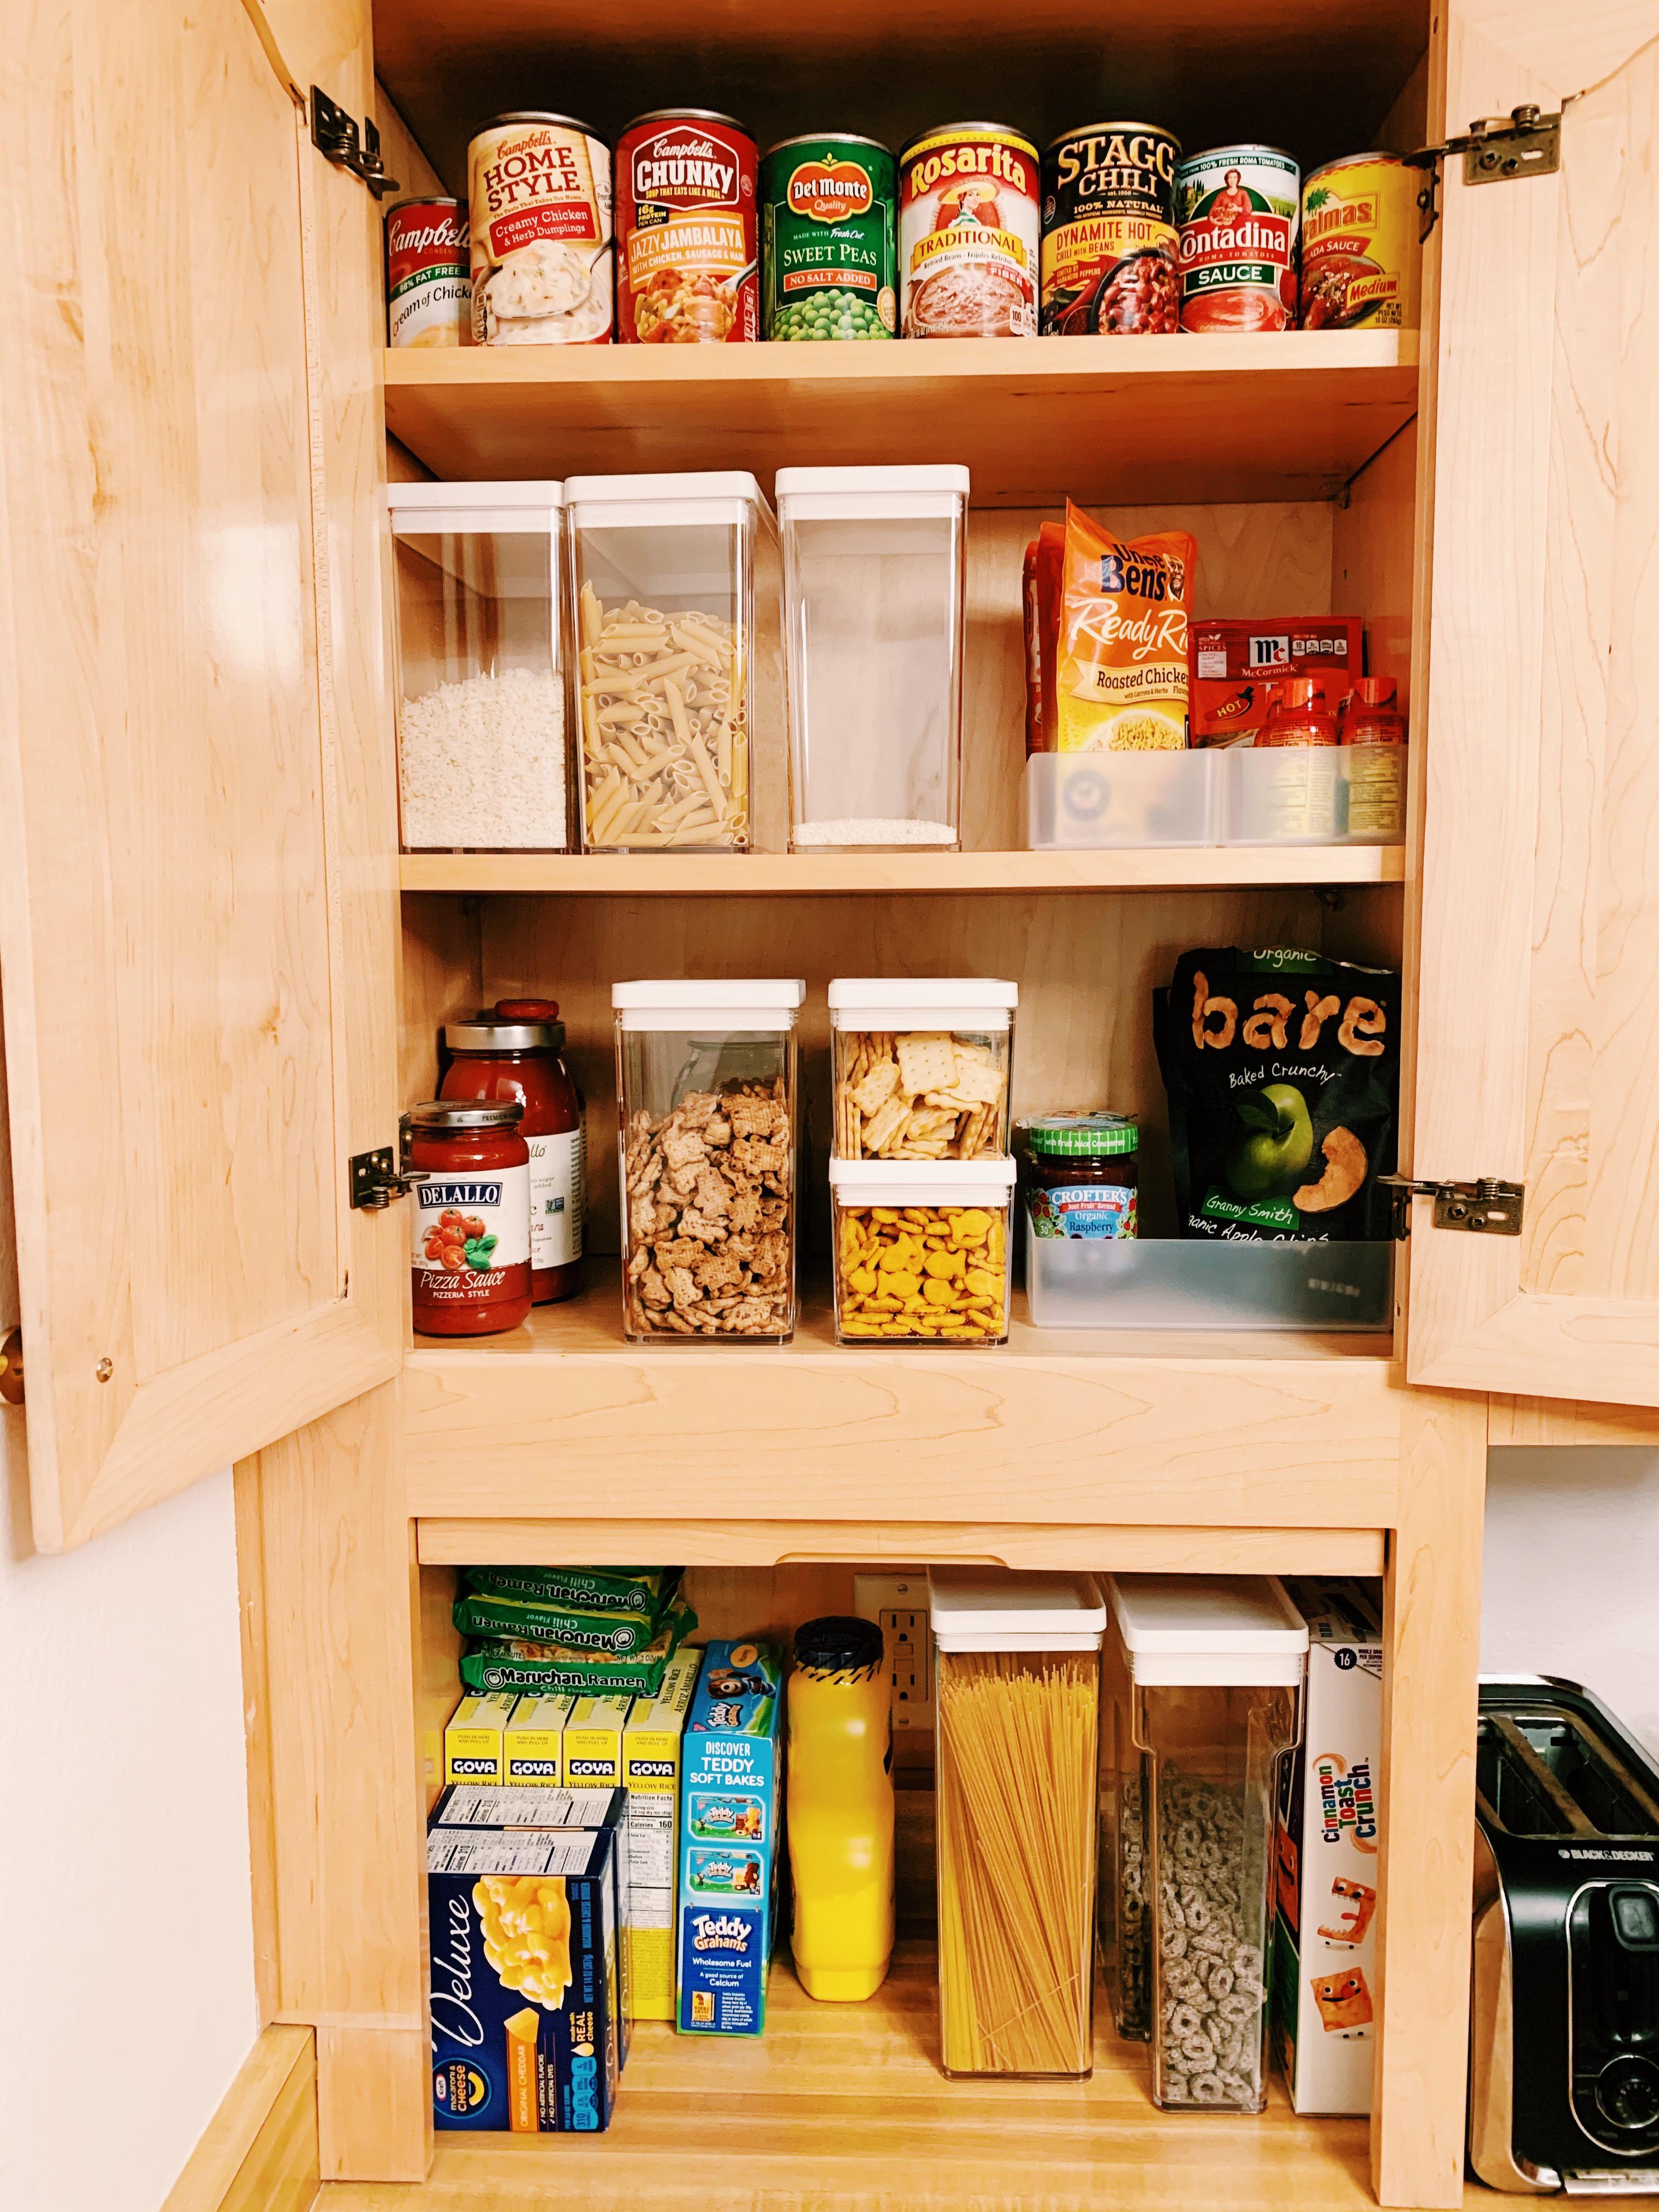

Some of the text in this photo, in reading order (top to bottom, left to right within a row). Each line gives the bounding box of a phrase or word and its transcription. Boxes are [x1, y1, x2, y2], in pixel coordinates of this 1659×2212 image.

[484, 147, 575, 192] HOME
[911, 144, 1026, 199] Rosarita
[1058, 135, 1175, 190] STAGG
[1200, 162, 1217, 171] 100%
[1219, 159, 1238, 167] FRESH
[1259, 157, 1285, 169] TOMATOES
[637, 160, 734, 194] CHUNKY
[1079, 168, 1157, 197] CHILI
[489, 171, 581, 212] STYLE
[646, 189, 658, 199] SOUP
[660, 187, 673, 196] THAT
[674, 187, 687, 195] EATS
[689, 187, 701, 195] LIKE
[707, 189, 720, 199] MEAL
[793, 178, 867, 199] Del Monte
[815, 200, 846, 212] Quality
[1074, 200, 1163, 213] 100% NATURAL
[496, 210, 588, 238] Creamy Chicken
[639, 211, 666, 221] PROTEIN
[505, 224, 585, 246] & Herb Dumplings
[920, 231, 1017, 257] TRADITIONAL
[1057, 222, 1152, 250] DYNAMITE HOT
[1179, 222, 1285, 262] Contadina
[631, 227, 743, 262] JAZZY JAMBALAYA
[1057, 242, 1114, 262] CHILI WITH BEANS
[1327, 241, 1360, 252] SAUCE
[633, 261, 647, 274] WITH
[649, 252, 684, 267] CHICKEN,
[685, 249, 721, 259] SAUSAGE
[784, 244, 877, 267] SWEET PEAS
[924, 256, 943, 269] Refried
[945, 252, 962, 261] Beans
[991, 254, 1012, 264] Refritos
[1199, 251, 1274, 262] ROMA TOMATOES
[400, 267, 461, 293] 98% FAT FREE
[791, 273, 871, 285] NO SALT ADDED
[1080, 268, 1101, 277] PEPPERS
[1198, 266, 1262, 285] SAUCE
[1350, 279, 1396, 301] Medium
[422, 292, 431, 307] of
[1013, 311, 1022, 321] 100
[1101, 555, 1167, 601] Ben's
[1070, 597, 1188, 661] Ready Ri
[1097, 671, 1143, 689] Roasted
[1242, 666, 1296, 677] McCormick
[1217, 699, 1242, 718] HOT
[1192, 970, 1387, 1057] bare
[1229, 1063, 1336, 1088] Baked Crunchy
[422, 1185, 498, 1204] DELALLO
[1052, 1189, 1127, 1204] CROFTER'S
[1075, 1211, 1109, 1221] Organic
[1207, 1196, 1294, 1224] Granny Smith
[1070, 1222, 1114, 1233] Raspberry
[420, 1271, 505, 1289] Pizza Sauce
[490, 1575, 544, 1595] Ramen
[543, 1573, 595, 1589] Chili Flavor
[472, 1616, 528, 1634] Ramen
[526, 1613, 578, 1629] Chili Flavor
[588, 1673, 646, 1688] Ramen
[660, 1680, 677, 1705] YELLOW
[708, 1702, 731, 1726] Teddy
[706, 1742, 751, 1756] DISCOVER
[454, 1760, 495, 1774] GOYA
[512, 1762, 554, 1776] GOYA
[571, 1762, 613, 1775] GOYA
[631, 1763, 673, 1776] GOYA
[701, 1757, 754, 1773] TEDDY
[690, 1773, 764, 1787] SOFT BAKES
[1318, 1766, 1339, 1843] Cinnamon
[1335, 1779, 1357, 1829] Toast
[1347, 1764, 1376, 1837] Crunch
[709, 1807, 732, 1818] Teddy
[458, 1845, 471, 1854] 310
[708, 1861, 732, 1872] Teddy
[693, 1915, 752, 1941] Teddy
[694, 1937, 747, 1952] Grahams
[693, 1957, 735, 1967] Wholesome
[429, 1895, 484, 2052] Deluxe
[710, 1979, 739, 1987] Calcium
[577, 2012, 585, 2041] REAL
[518, 2045, 528, 2126] ORIGINAL CHEDDAR
[540, 2108, 546, 2118] NO
[549, 2108, 555, 2118] NO
[577, 2113, 585, 2127] 310
